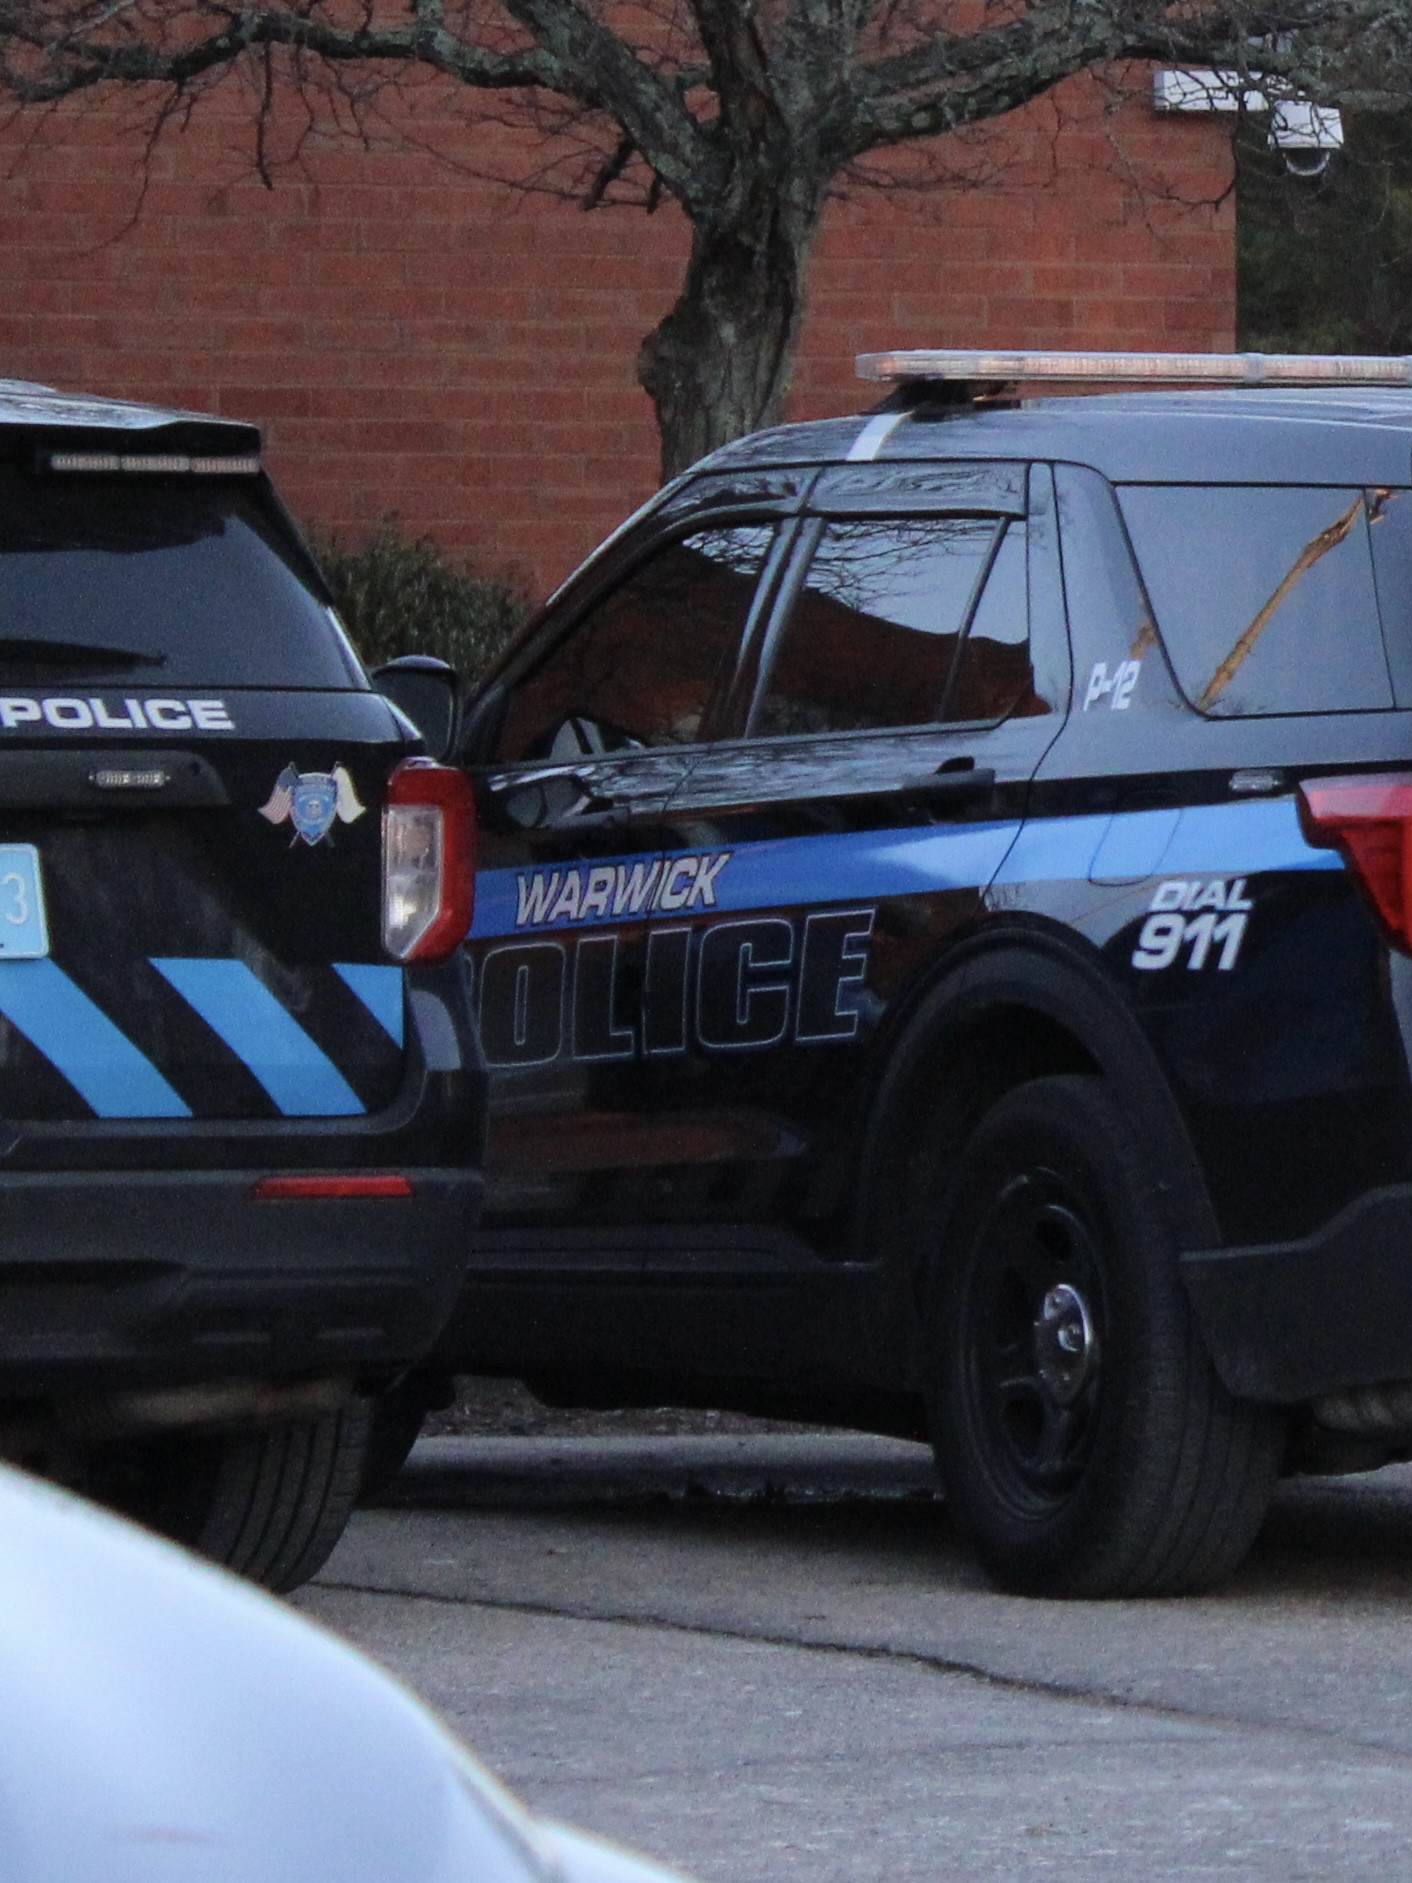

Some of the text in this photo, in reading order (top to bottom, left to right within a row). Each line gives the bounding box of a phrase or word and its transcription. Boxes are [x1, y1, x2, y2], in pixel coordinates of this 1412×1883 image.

[1084, 661, 1141, 711] P-12
[0, 697, 234, 730] POLICE
[516, 851, 734, 926] WARWICK
[1150, 880, 1252, 911] DIAL
[1131, 913, 1248, 971] 911
[463, 906, 876, 1068] OLICE
